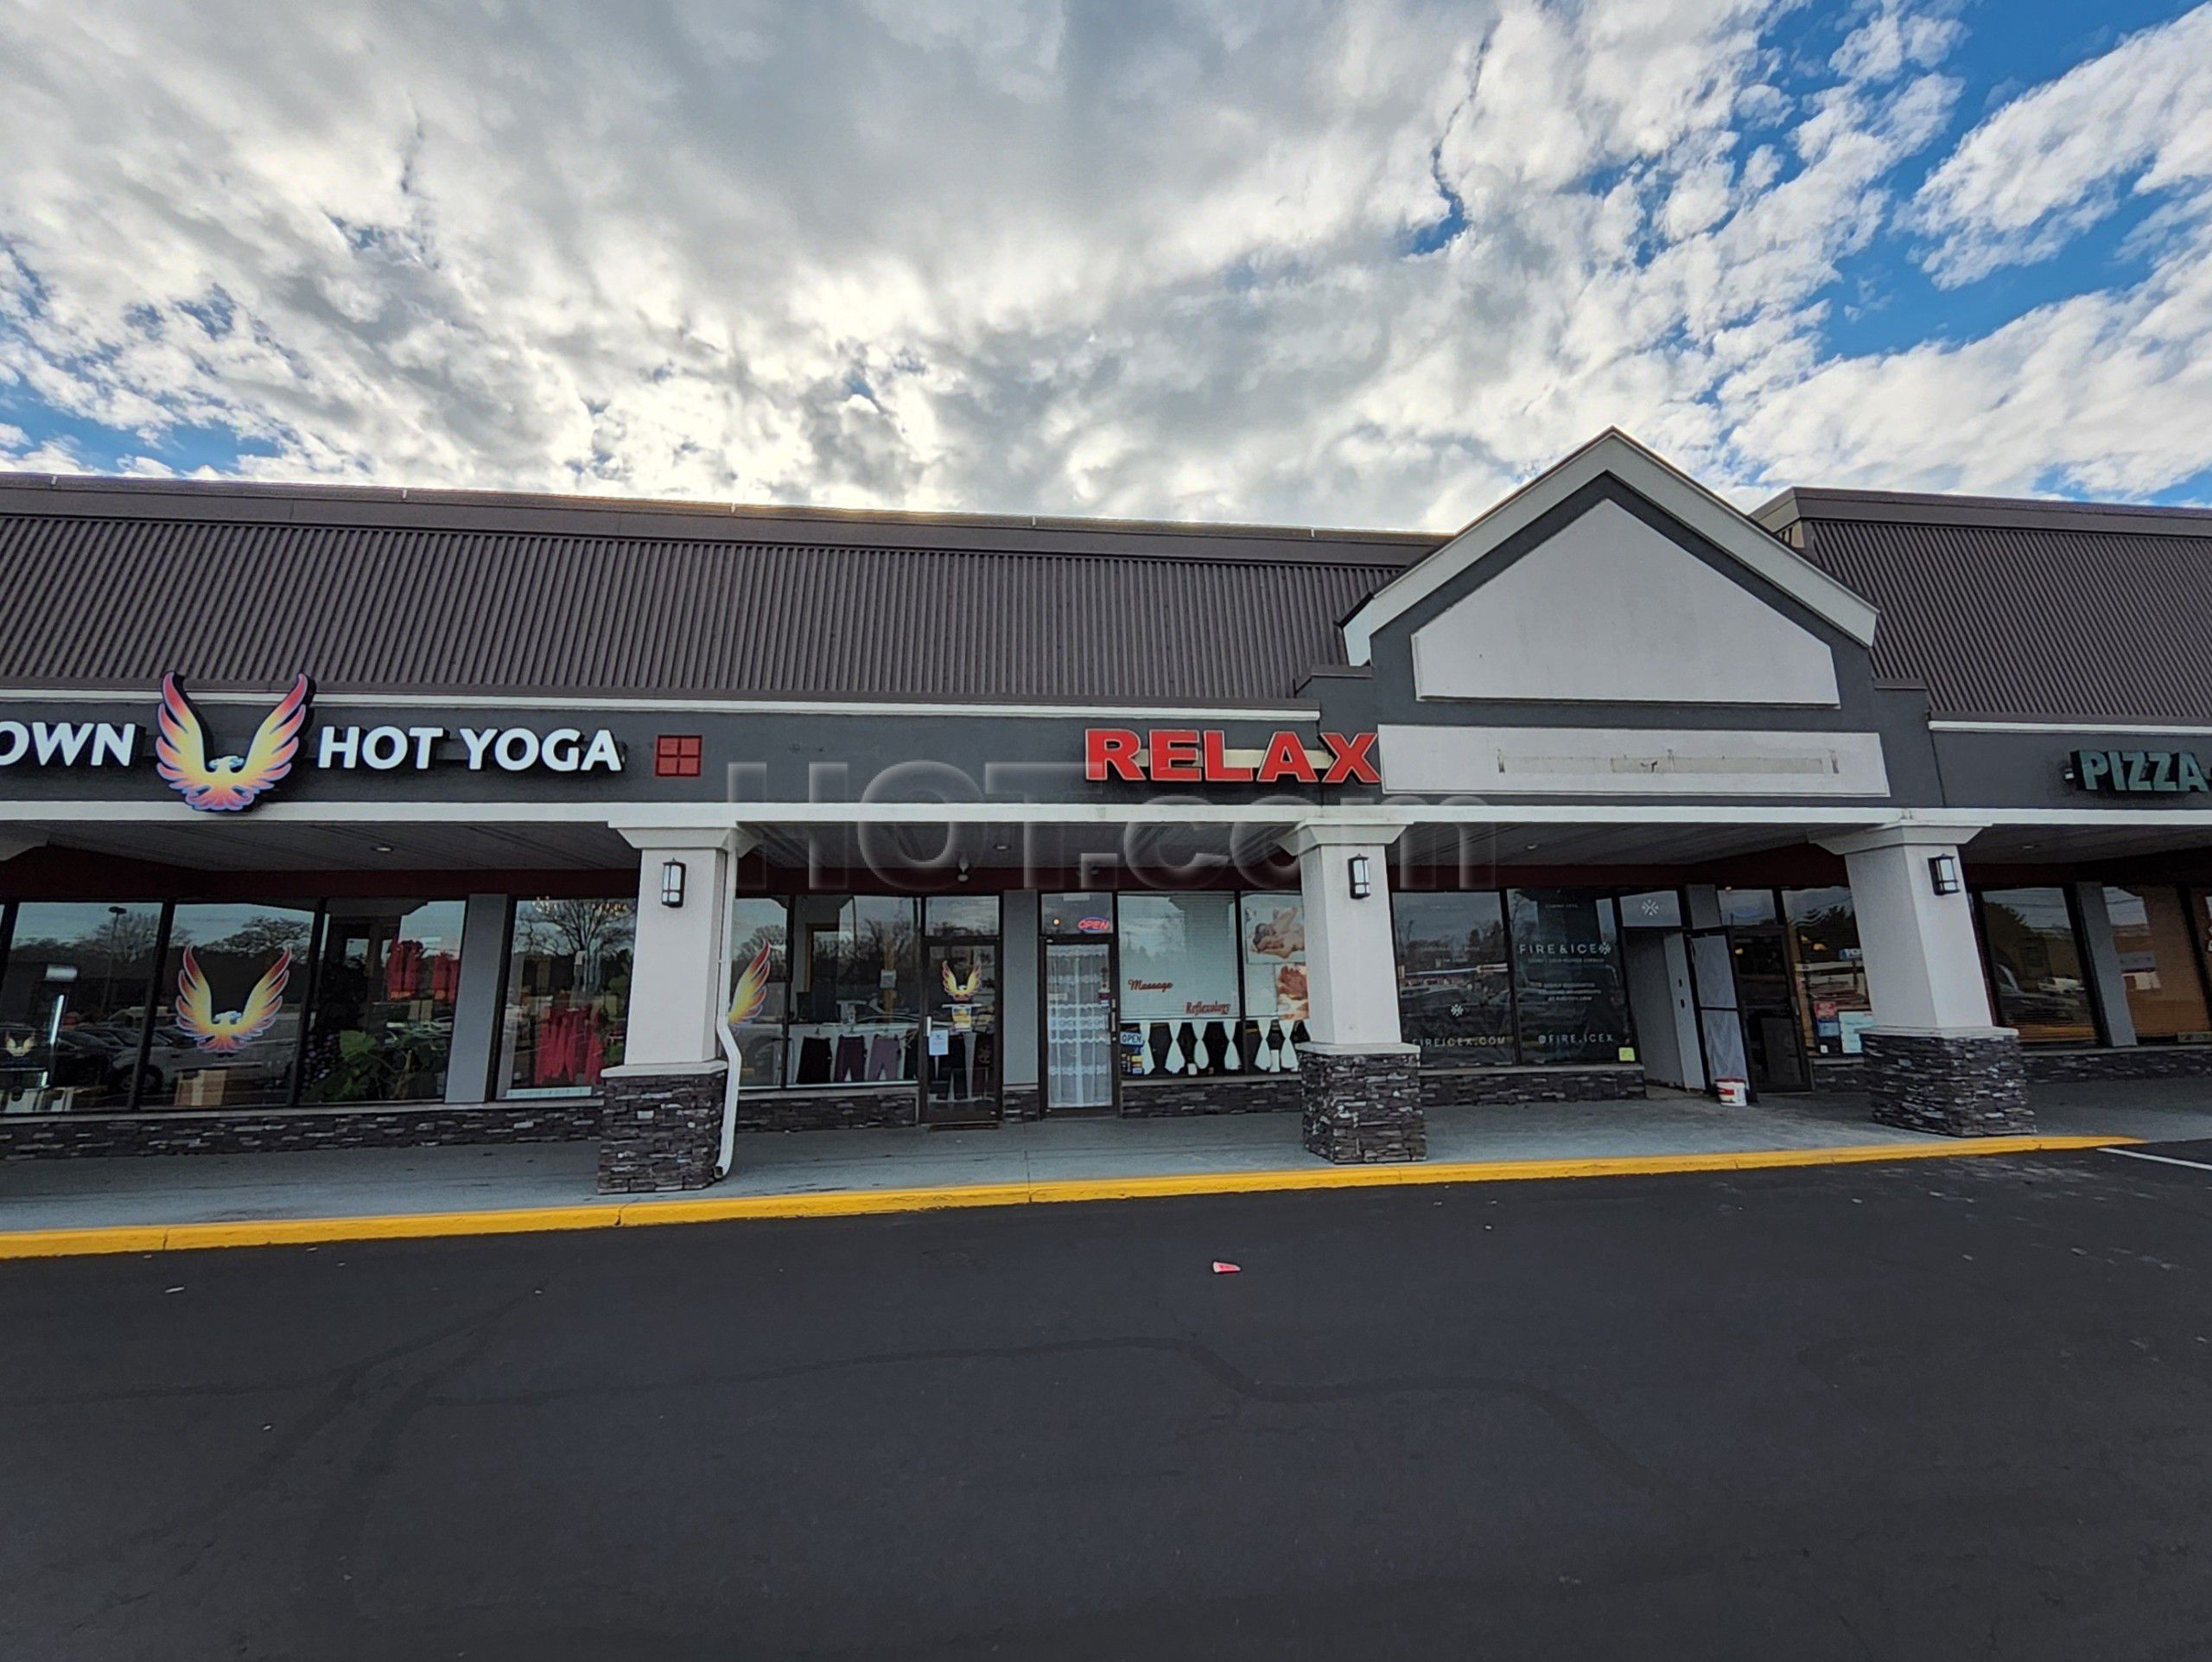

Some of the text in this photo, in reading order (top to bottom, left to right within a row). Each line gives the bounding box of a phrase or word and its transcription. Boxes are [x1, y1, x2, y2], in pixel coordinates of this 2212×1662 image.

[0, 720, 622, 772] OWN HOT YOGA
[1084, 728, 1382, 785] RELAX
[2077, 749, 2209, 792] PIZZA
[1078, 920, 1110, 930] OPEN
[1128, 978, 1174, 993] Massage
[1185, 1001, 1231, 1016] Reflexology
[1122, 1033, 1142, 1044] OPEN
